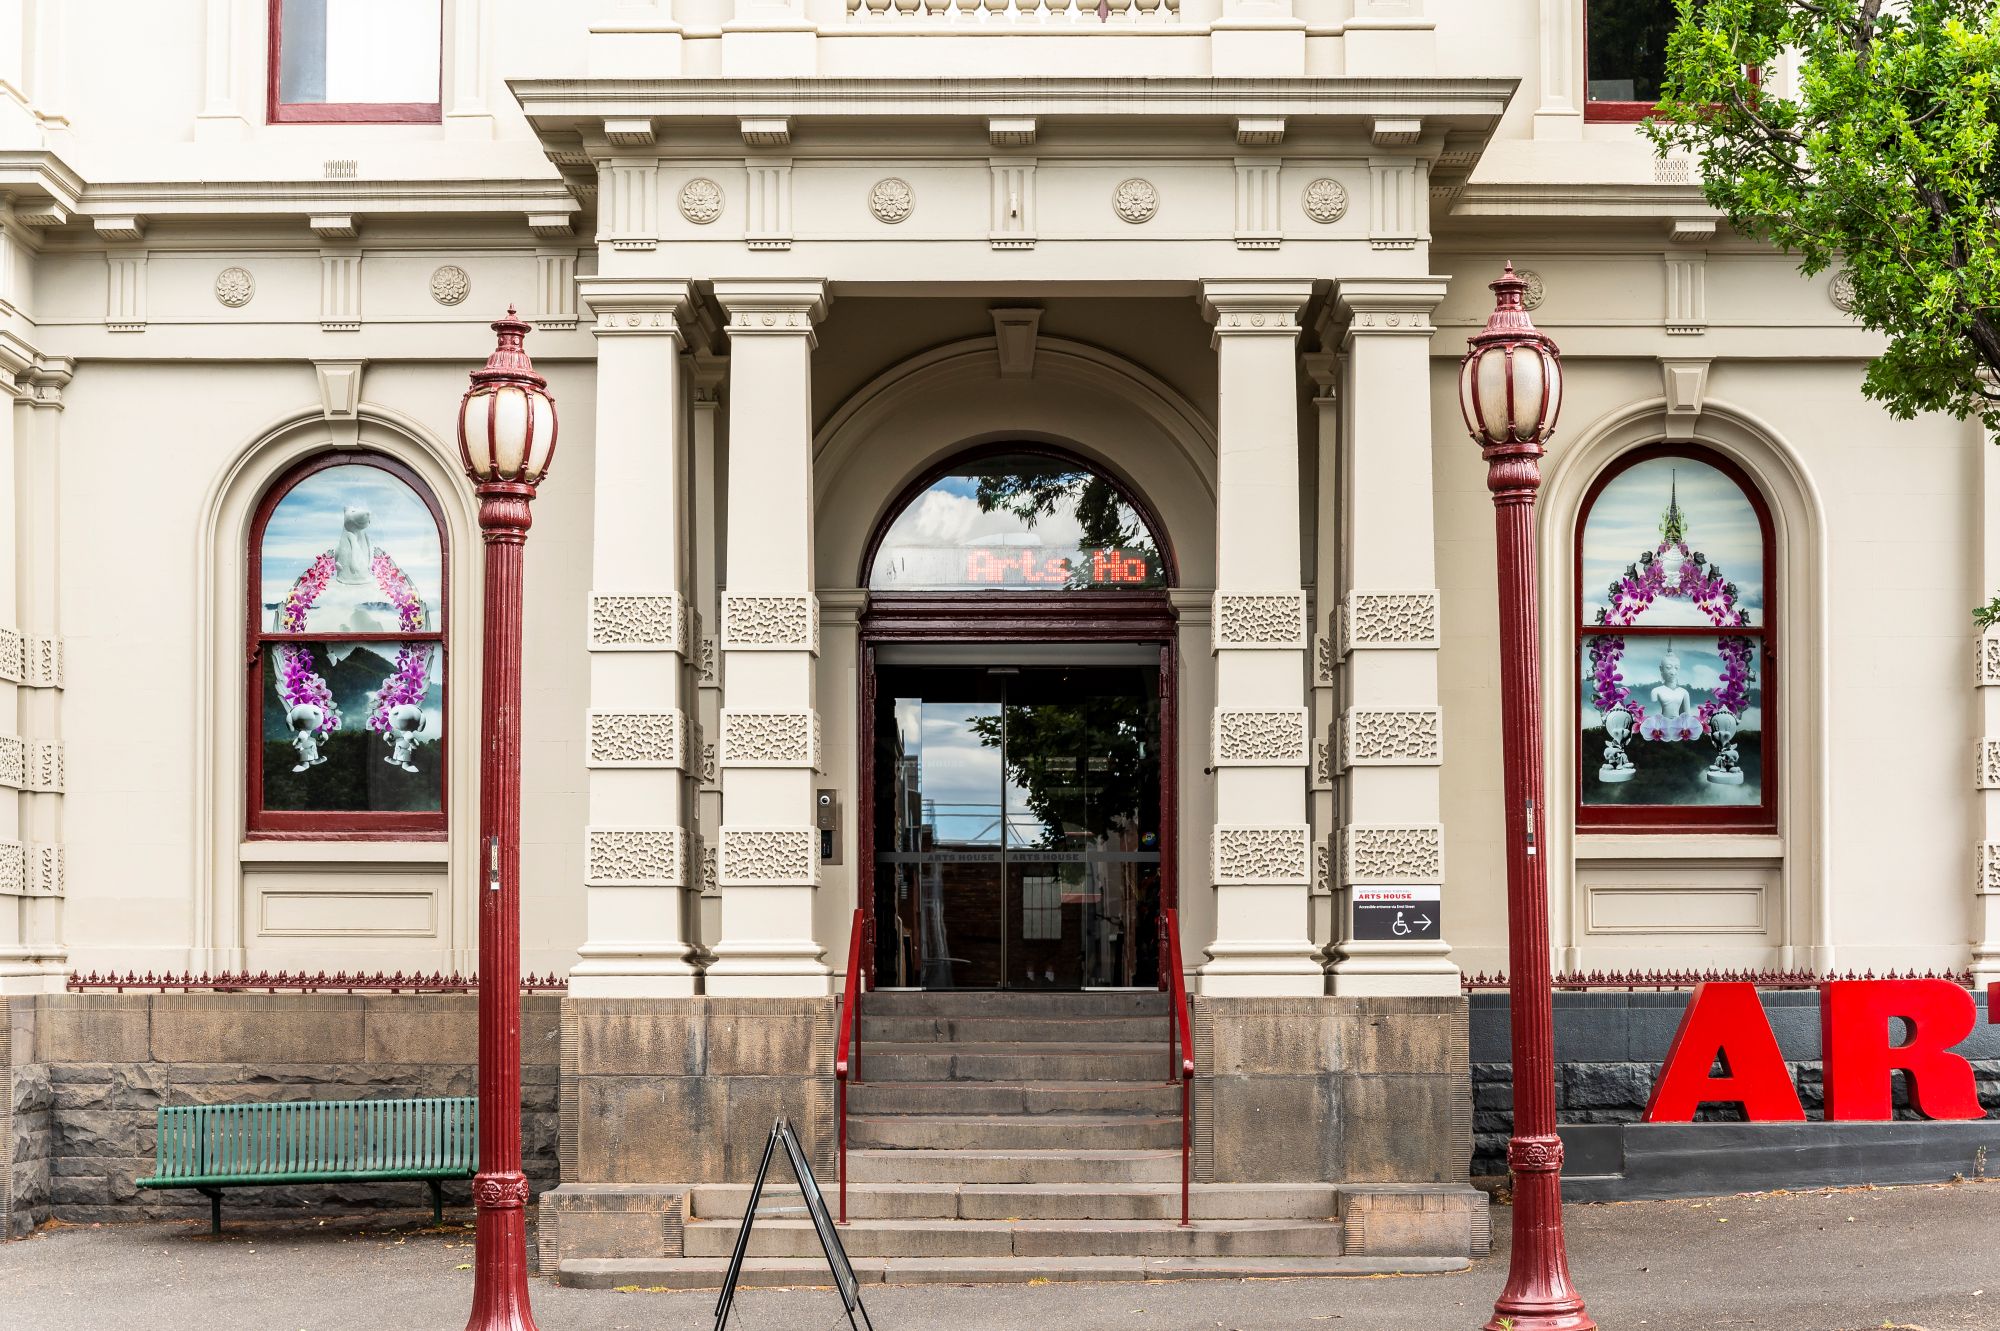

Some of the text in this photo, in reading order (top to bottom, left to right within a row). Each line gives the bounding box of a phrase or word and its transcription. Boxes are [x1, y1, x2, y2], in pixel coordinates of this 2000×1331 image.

[968, 550, 1146, 582] Arts Ho
[927, 853, 995, 862] ARTS HOUSE
[1012, 853, 1080, 861] ARTS HOUSE
[1641, 979, 2000, 1122] AR
